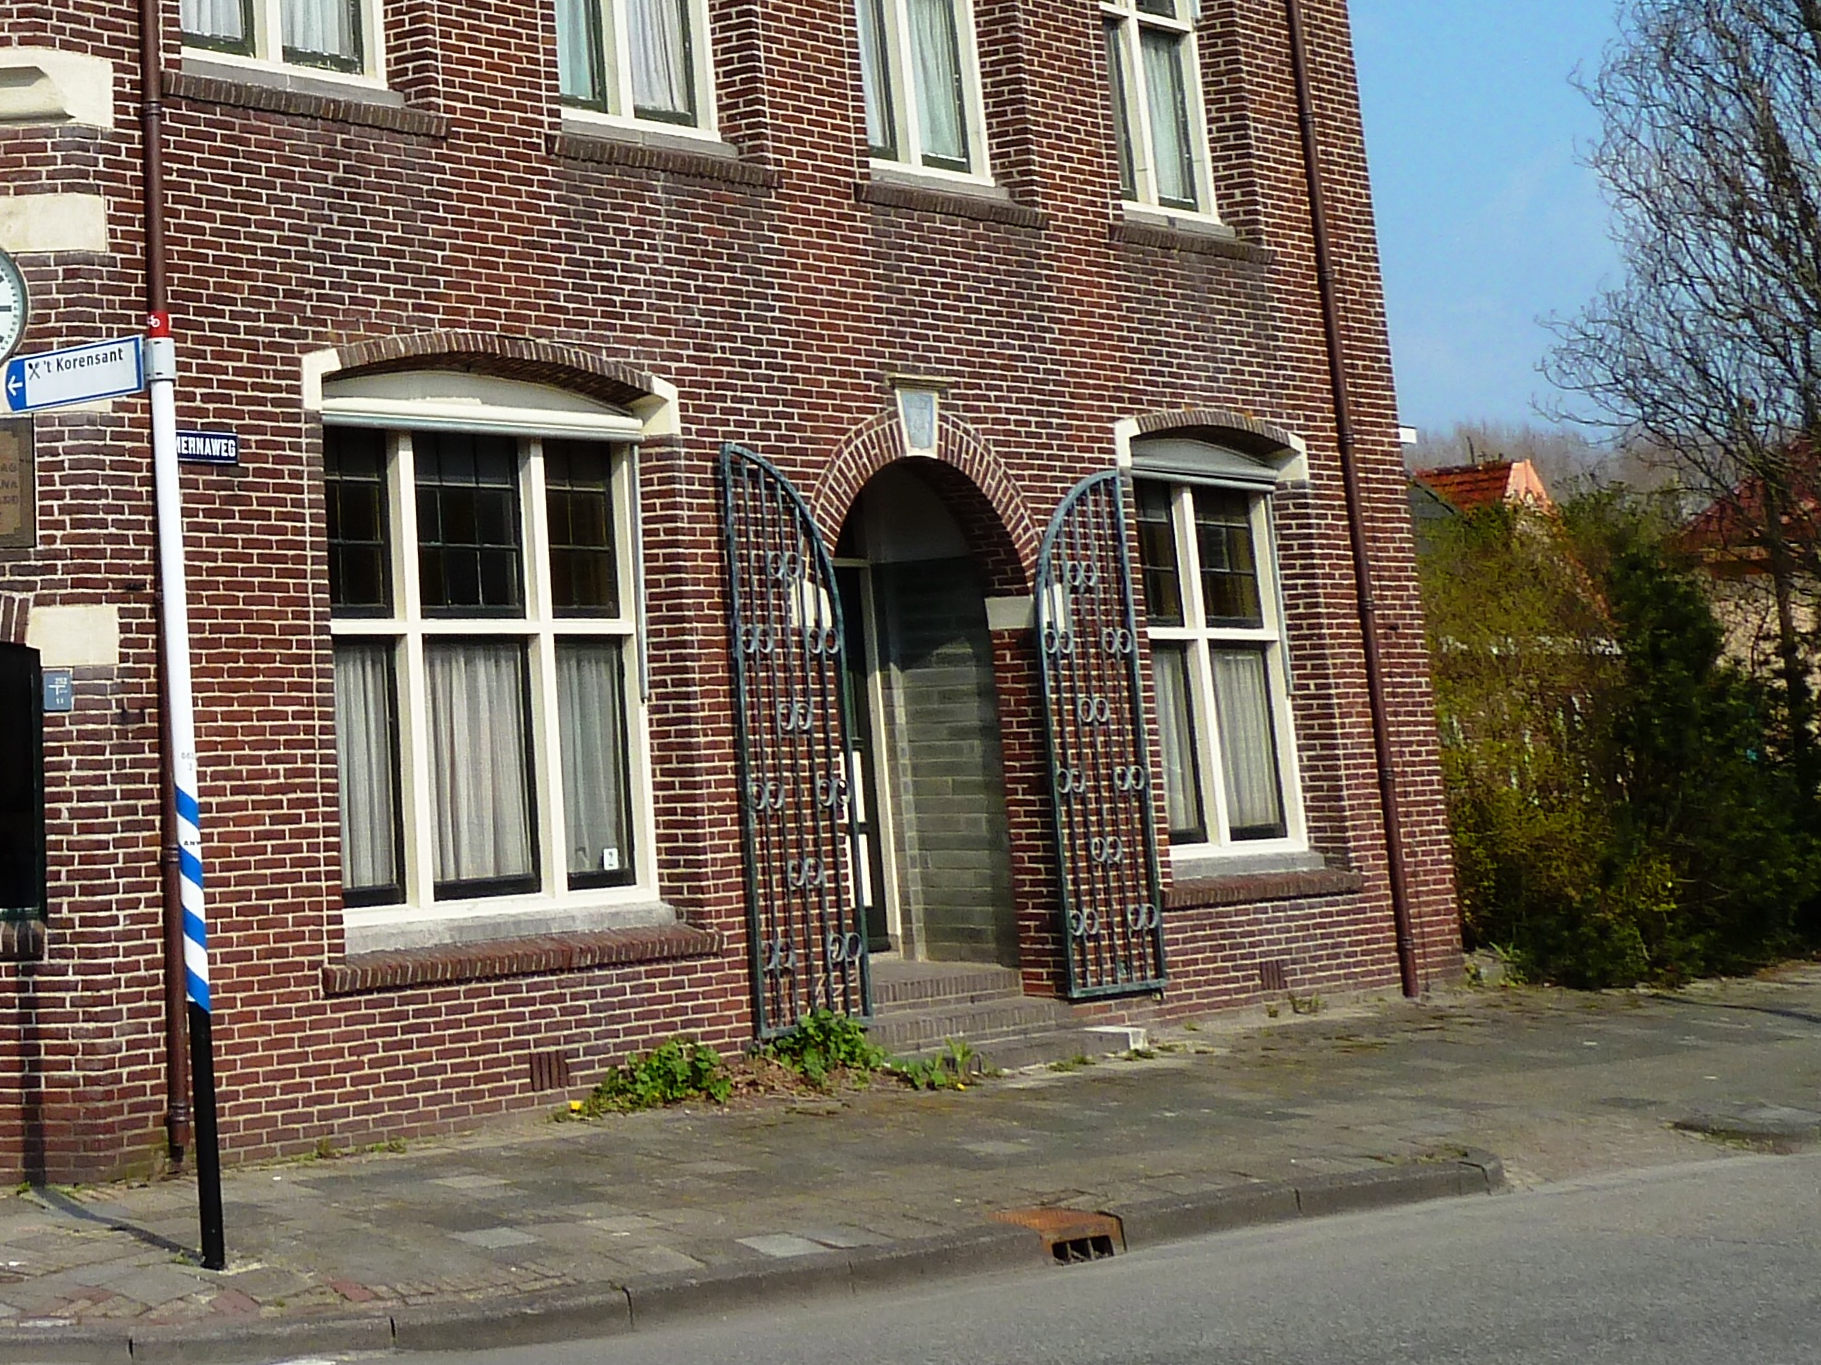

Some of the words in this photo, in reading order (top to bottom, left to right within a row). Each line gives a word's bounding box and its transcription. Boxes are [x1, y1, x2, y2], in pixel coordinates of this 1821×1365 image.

[43, 359, 52, 374] 't
[56, 347, 124, 373] Korensant
[176, 436, 237, 458] ERNAWEG
